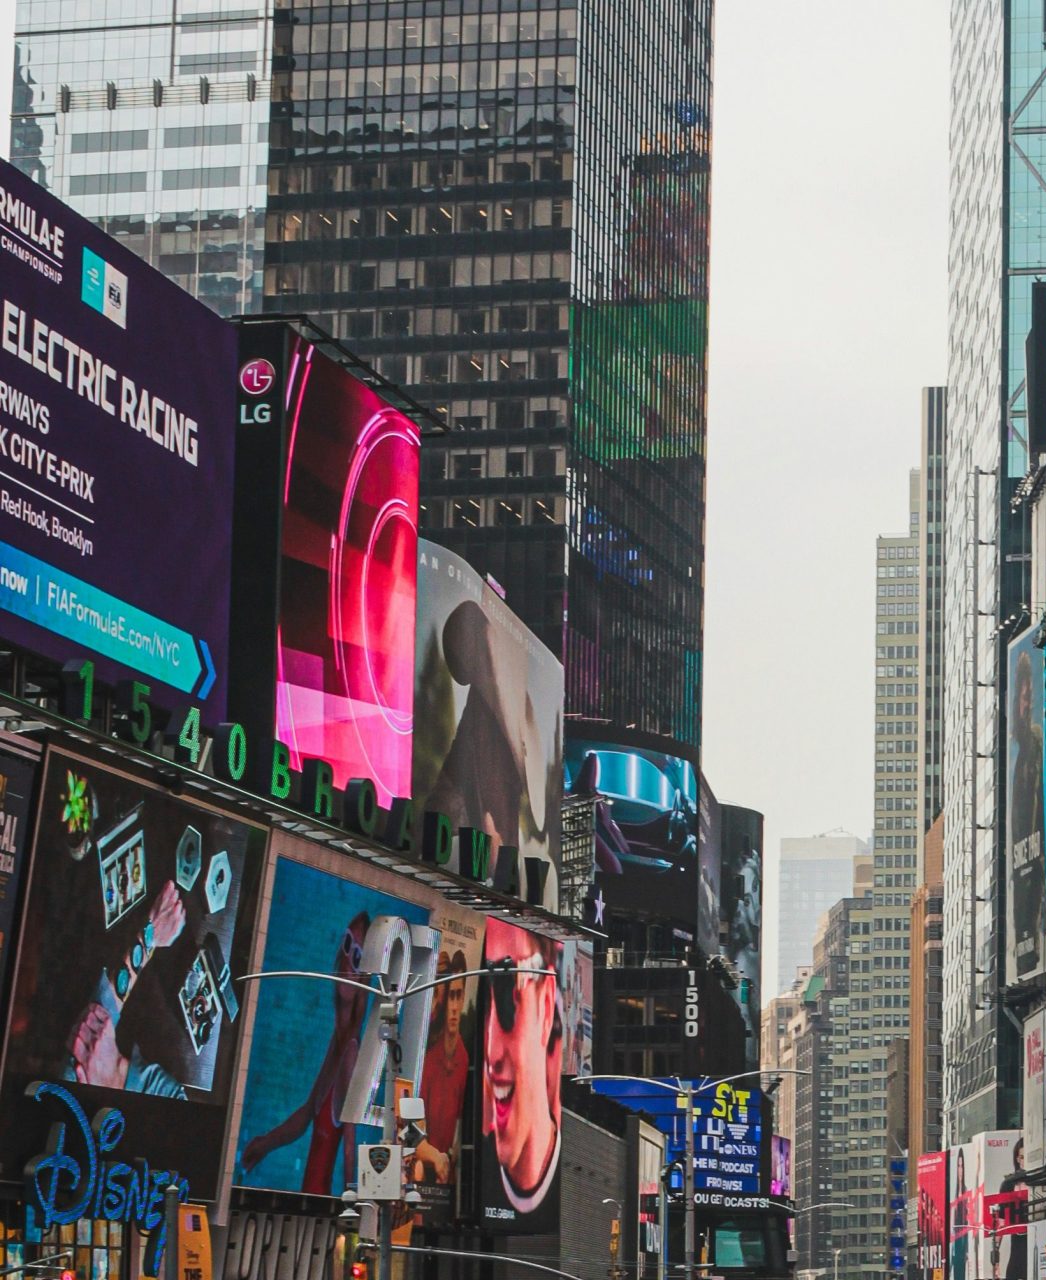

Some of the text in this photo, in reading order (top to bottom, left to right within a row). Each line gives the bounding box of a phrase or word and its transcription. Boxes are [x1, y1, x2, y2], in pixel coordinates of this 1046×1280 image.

[1, 234, 63, 285] CHAMPIONSHIP
[2, 299, 199, 467] ELECTRIC RACING
[239, 404, 272, 424] LG
[10, 432, 47, 476] CITY
[46, 452, 95, 504] E-PRIX
[1, 490, 94, 556] Red Hook, Brooklyn
[420, 553, 439, 570] AN
[1, 566, 180, 667] now FIAFormulaE.com/NYC
[78, 659, 550, 907] 1540 BROADWAY
[685, 970, 699, 1037] 1500
[692, 1158, 708, 1168] HE
[720, 1161, 755, 1174] PODCAST
[732, 1144, 758, 1156] NEWS
[693, 1193, 709, 1204] OU
